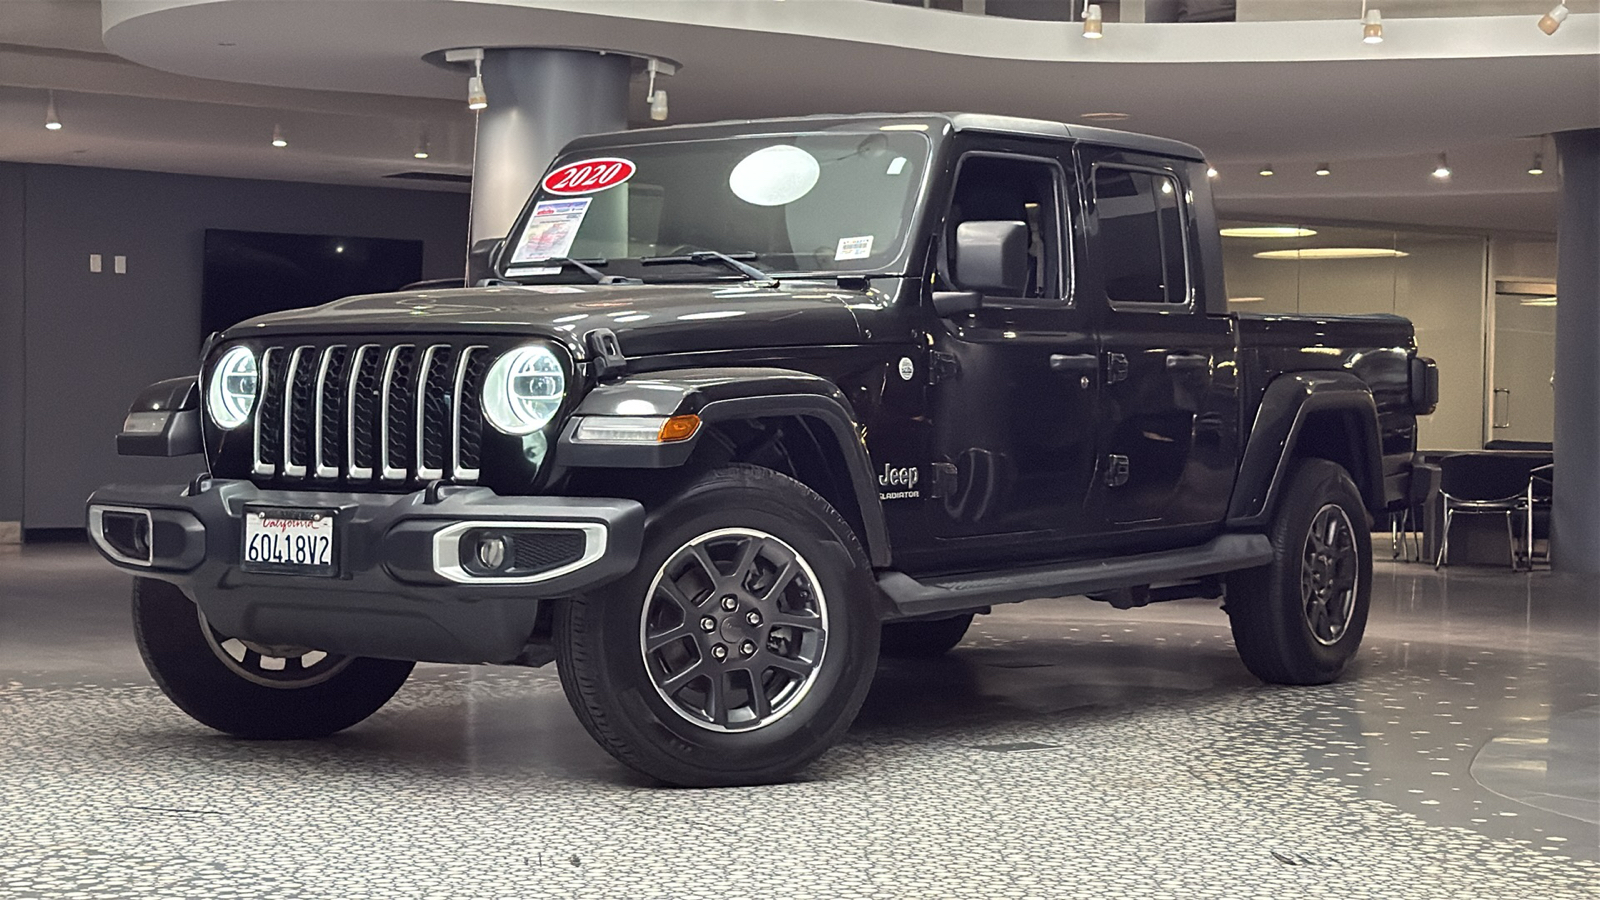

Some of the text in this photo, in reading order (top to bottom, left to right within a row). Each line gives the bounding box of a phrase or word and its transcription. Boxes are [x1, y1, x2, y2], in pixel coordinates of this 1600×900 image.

[552, 162, 623, 190] 2020
[878, 463, 918, 489] Jeep
[248, 533, 329, 564] 60418V2
